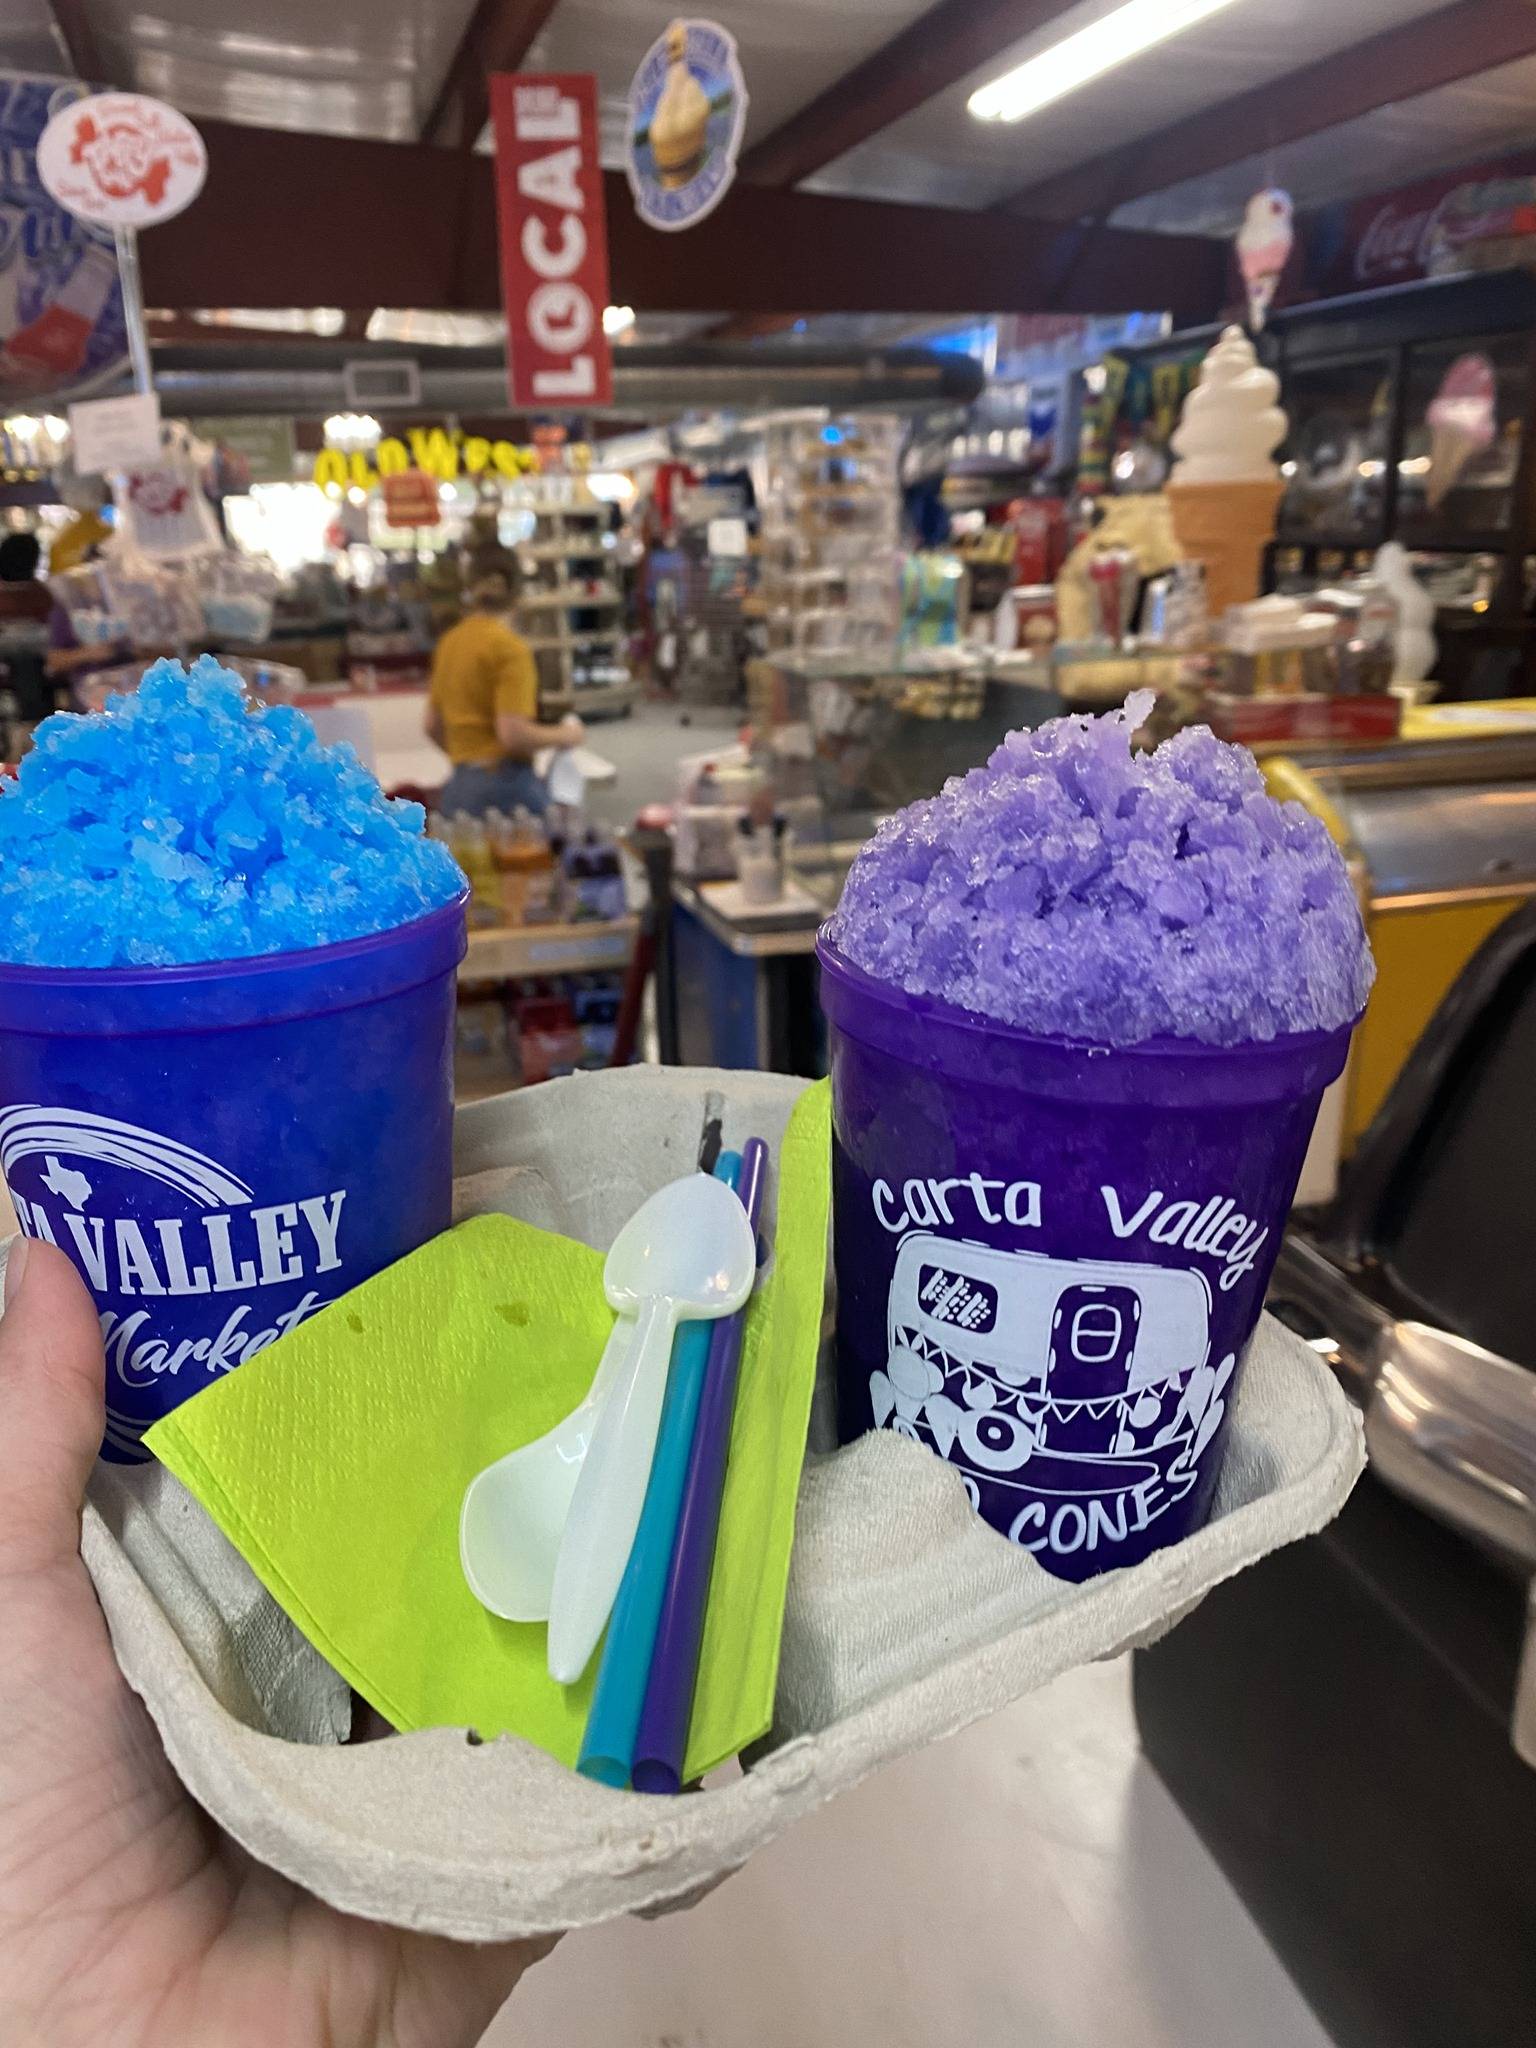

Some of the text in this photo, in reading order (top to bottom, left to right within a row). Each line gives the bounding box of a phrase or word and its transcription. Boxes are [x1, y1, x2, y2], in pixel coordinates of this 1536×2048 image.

[63, 1190, 347, 1296] VALLEY
[872, 1172, 1268, 1291] Carta Valley
[1008, 1446, 1198, 1554] CONES
